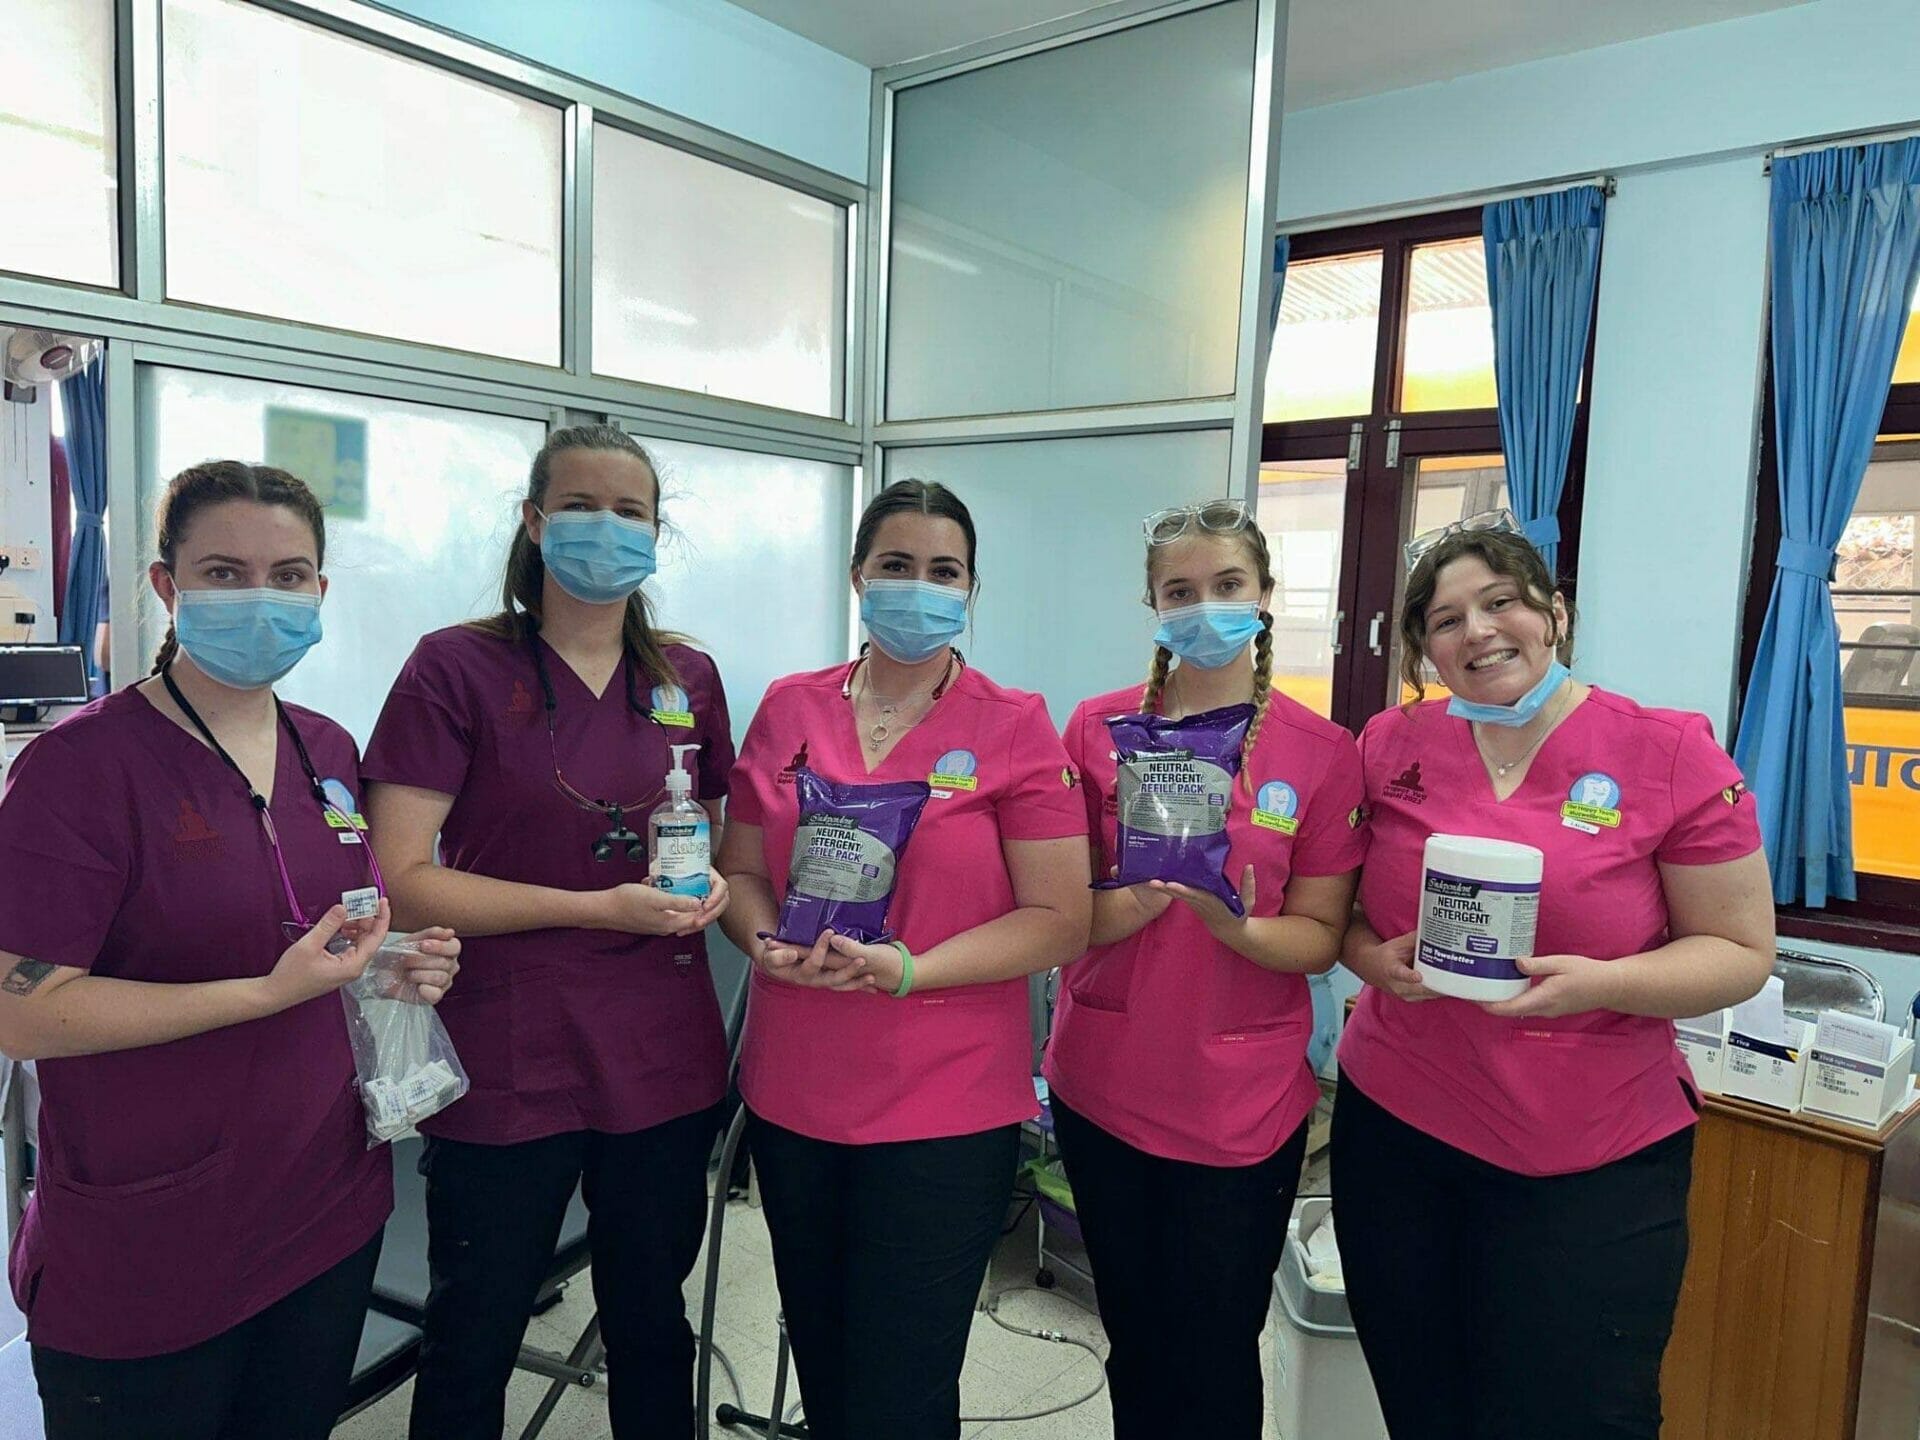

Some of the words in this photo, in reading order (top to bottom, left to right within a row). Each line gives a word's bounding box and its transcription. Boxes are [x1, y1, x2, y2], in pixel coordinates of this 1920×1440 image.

[1149, 763, 1195, 773] NEUTRAL
[1143, 773, 1202, 783] DETERGENT
[1141, 783, 1174, 793] REFILL
[1177, 783, 1205, 793] PACK
[816, 827, 857, 841] NEUTRAL
[811, 837, 861, 852] DETERGENT
[808, 847, 834, 858] REFILL
[836, 850, 861, 862] PACK
[1438, 896, 1483, 912] NEUTRAL
[1432, 907, 1490, 924] DETERGENT
[1433, 947, 1475, 965] Towelettes
